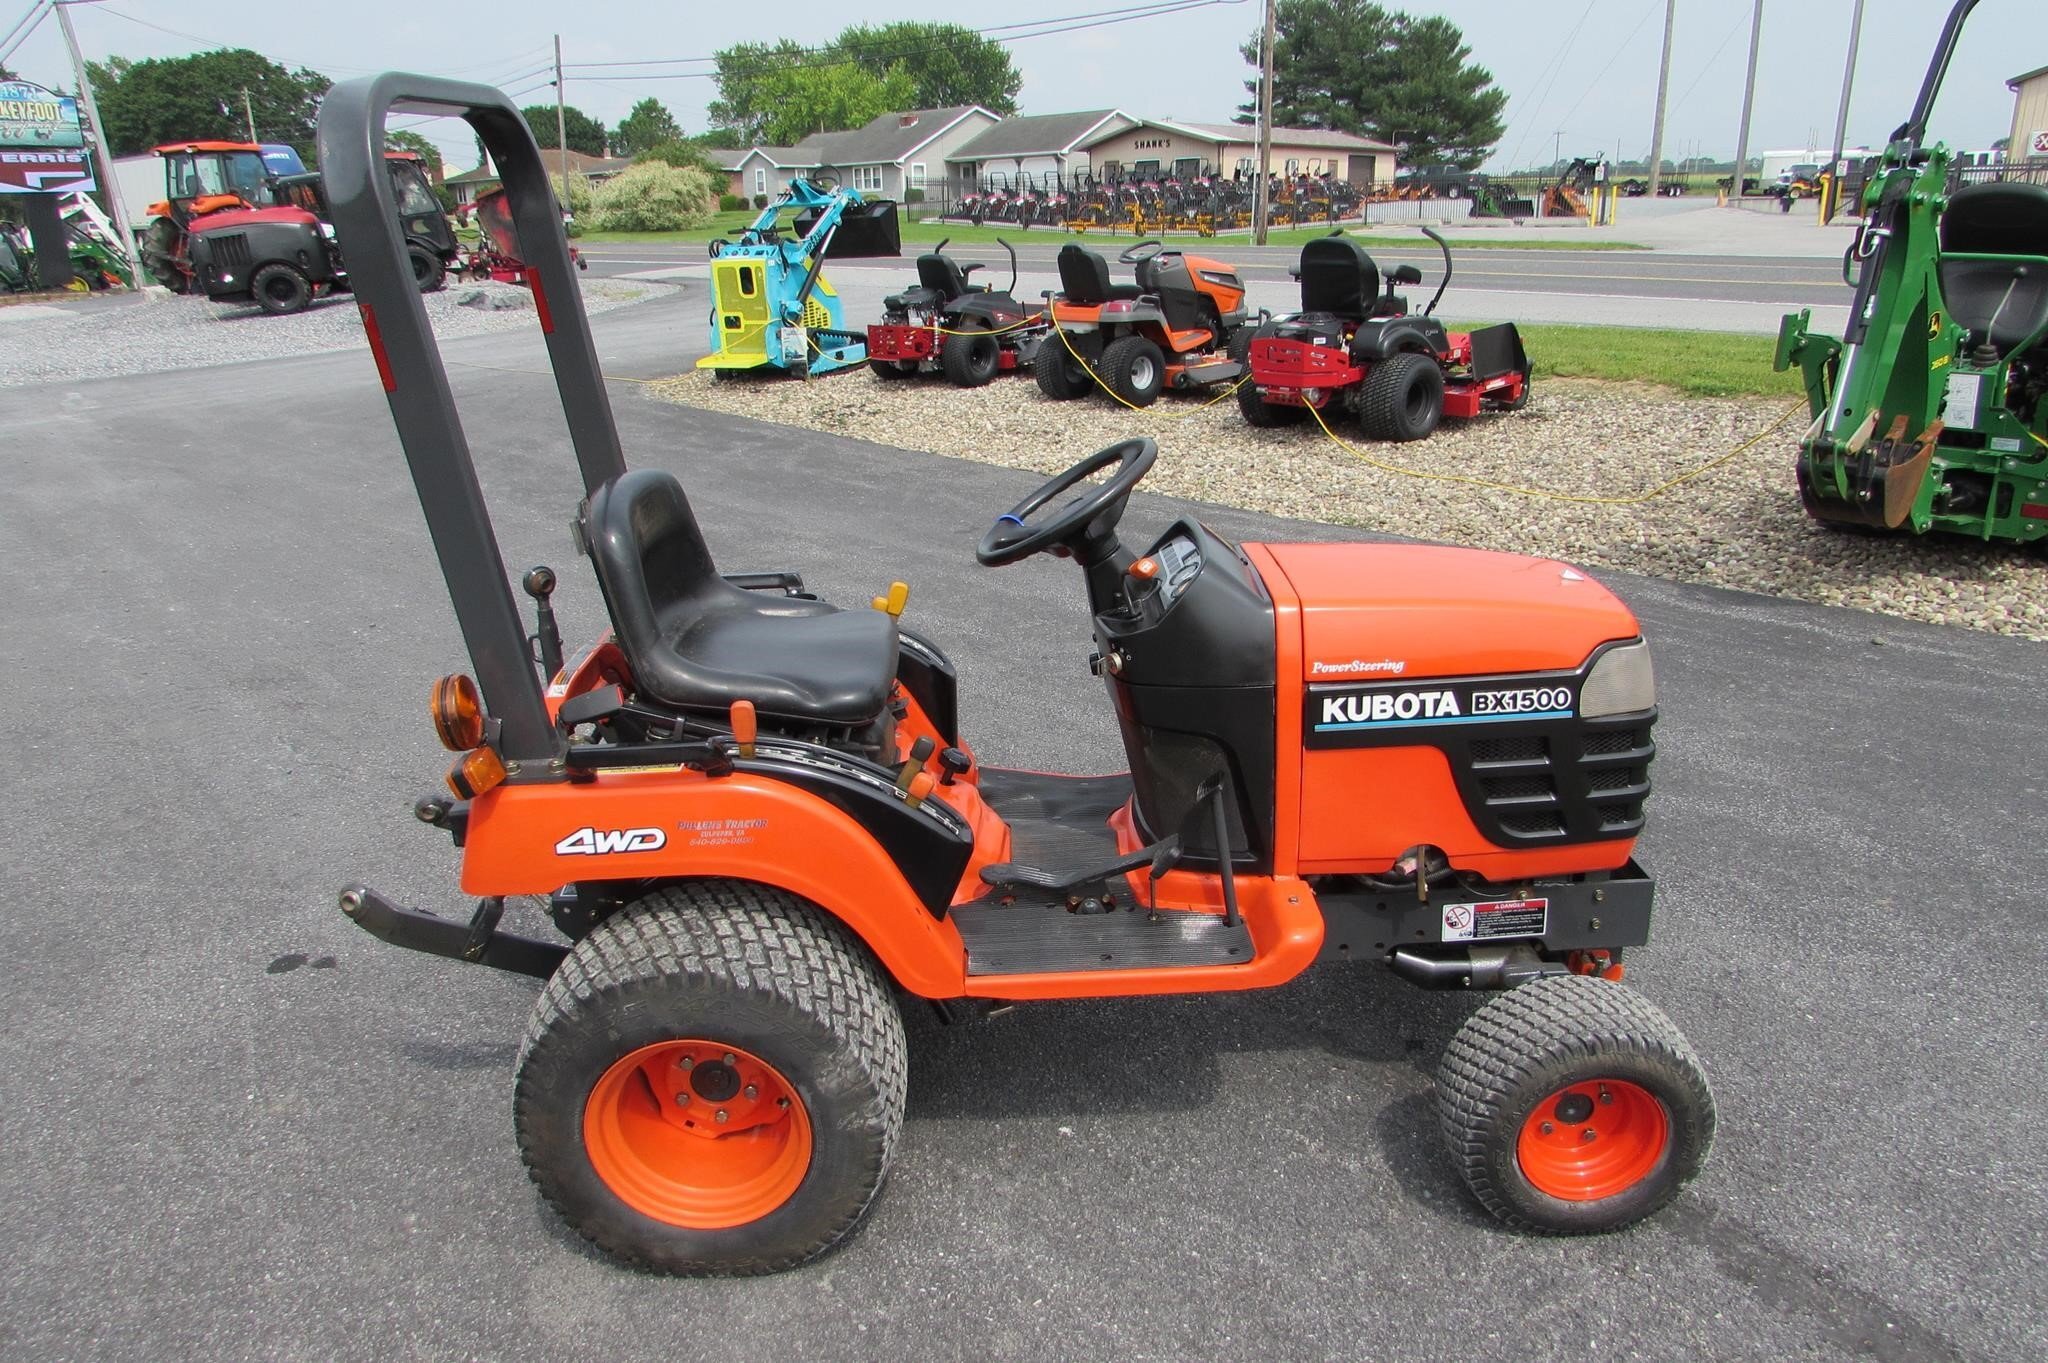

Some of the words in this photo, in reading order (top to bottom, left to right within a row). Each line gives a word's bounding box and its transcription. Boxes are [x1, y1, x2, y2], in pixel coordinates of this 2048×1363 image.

[1134, 139, 1171, 150] SHANK'S
[1321, 690, 1460, 723] KUBOTA
[1471, 687, 1572, 715] BX1500
[725, 818, 769, 829] TRACTOR
[554, 826, 668, 856] 4WD
[1500, 902, 1526, 910] DANGER
